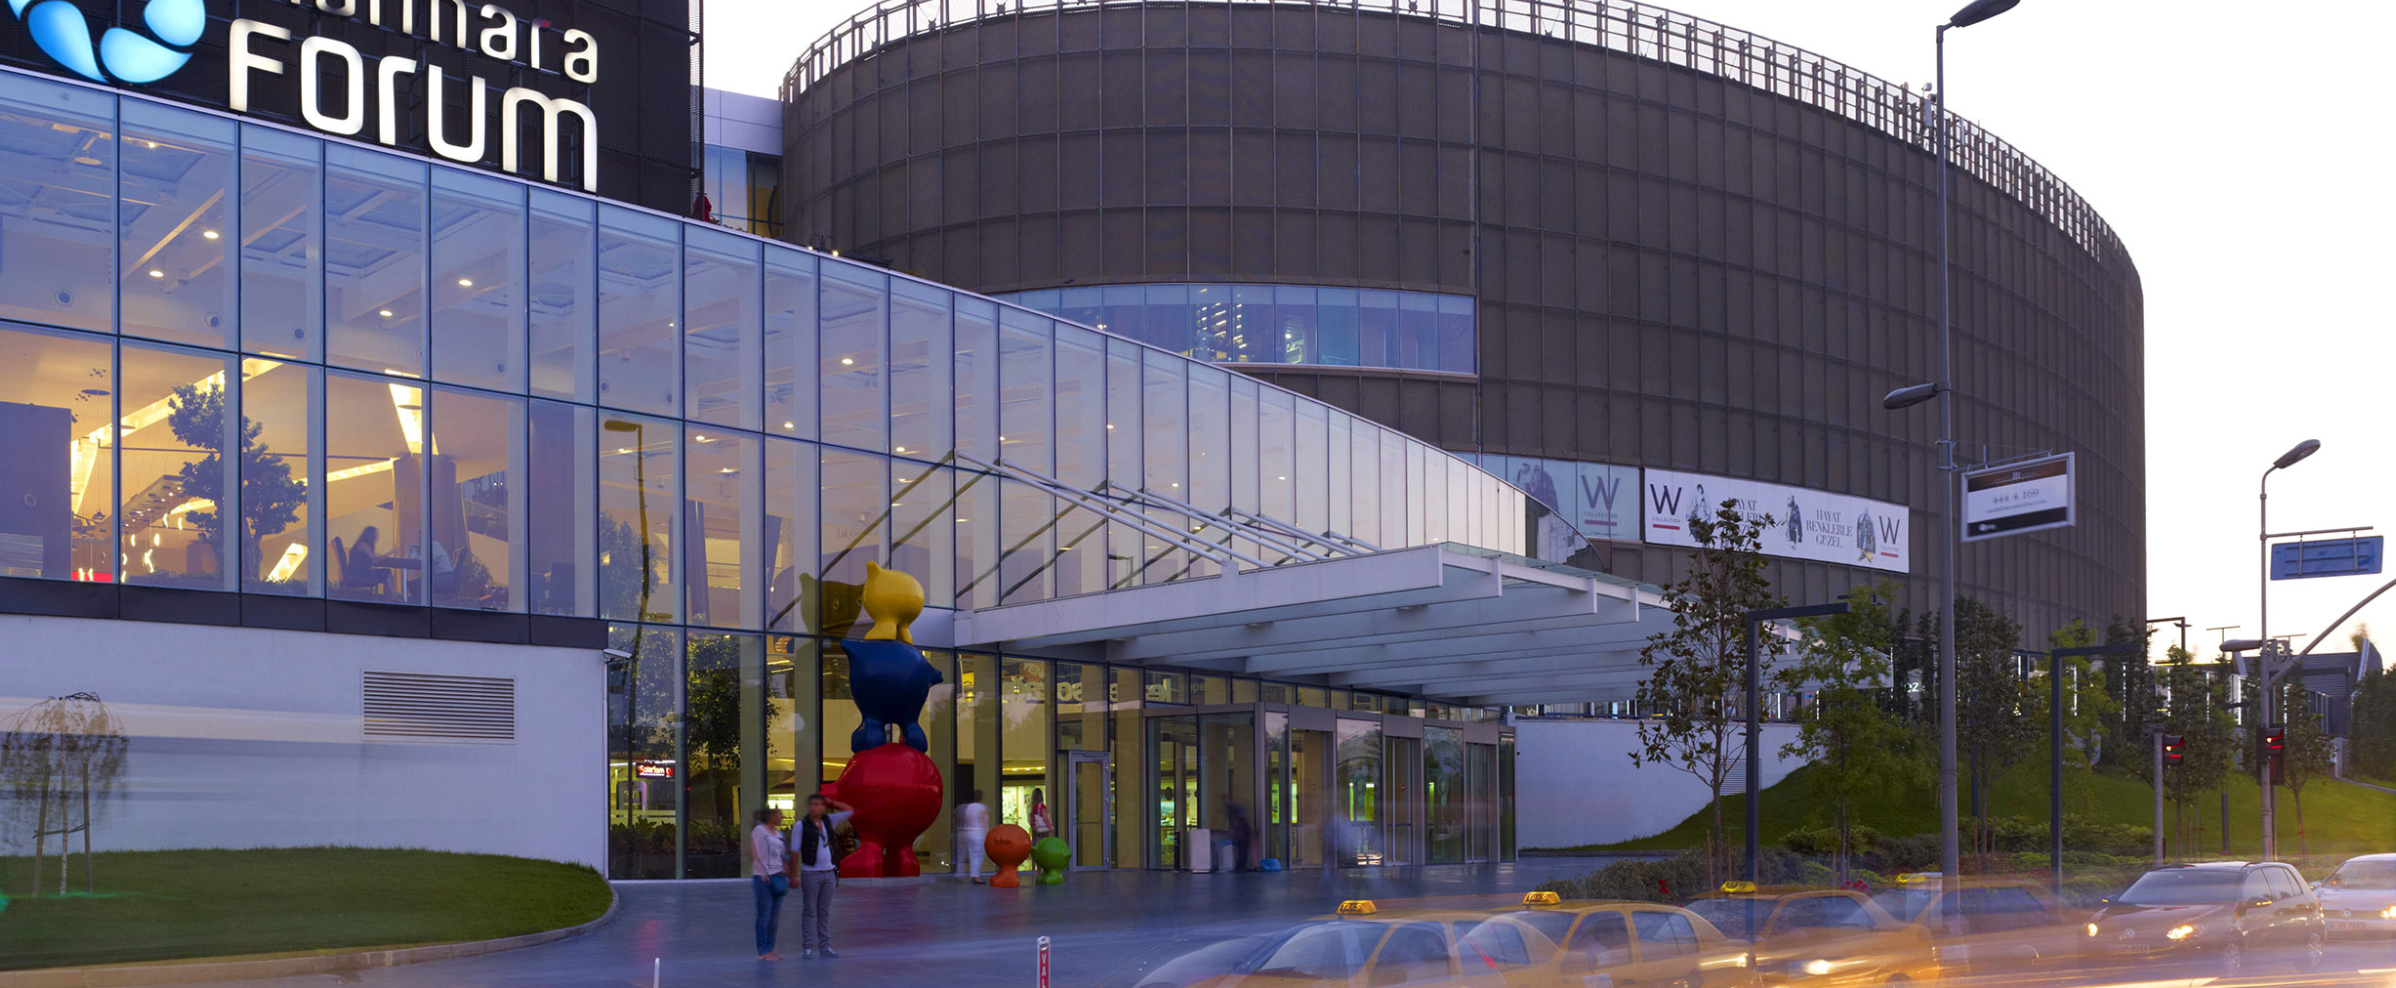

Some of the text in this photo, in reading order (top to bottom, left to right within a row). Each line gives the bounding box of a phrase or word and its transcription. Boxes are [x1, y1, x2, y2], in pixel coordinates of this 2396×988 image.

[229, 18, 597, 192] Forum
[1581, 475, 1620, 509] W
[1650, 484, 1682, 515] W
[2022, 488, 2039, 499] 169
[1728, 497, 1757, 511] AYAT
[1584, 511, 1617, 519] COLLECTON
[1652, 515, 1680, 523] COLLECTION
[1816, 509, 1841, 523] HAYAT
[1806, 520, 1853, 537] RENKLERLE
[1879, 515, 1900, 545] W
